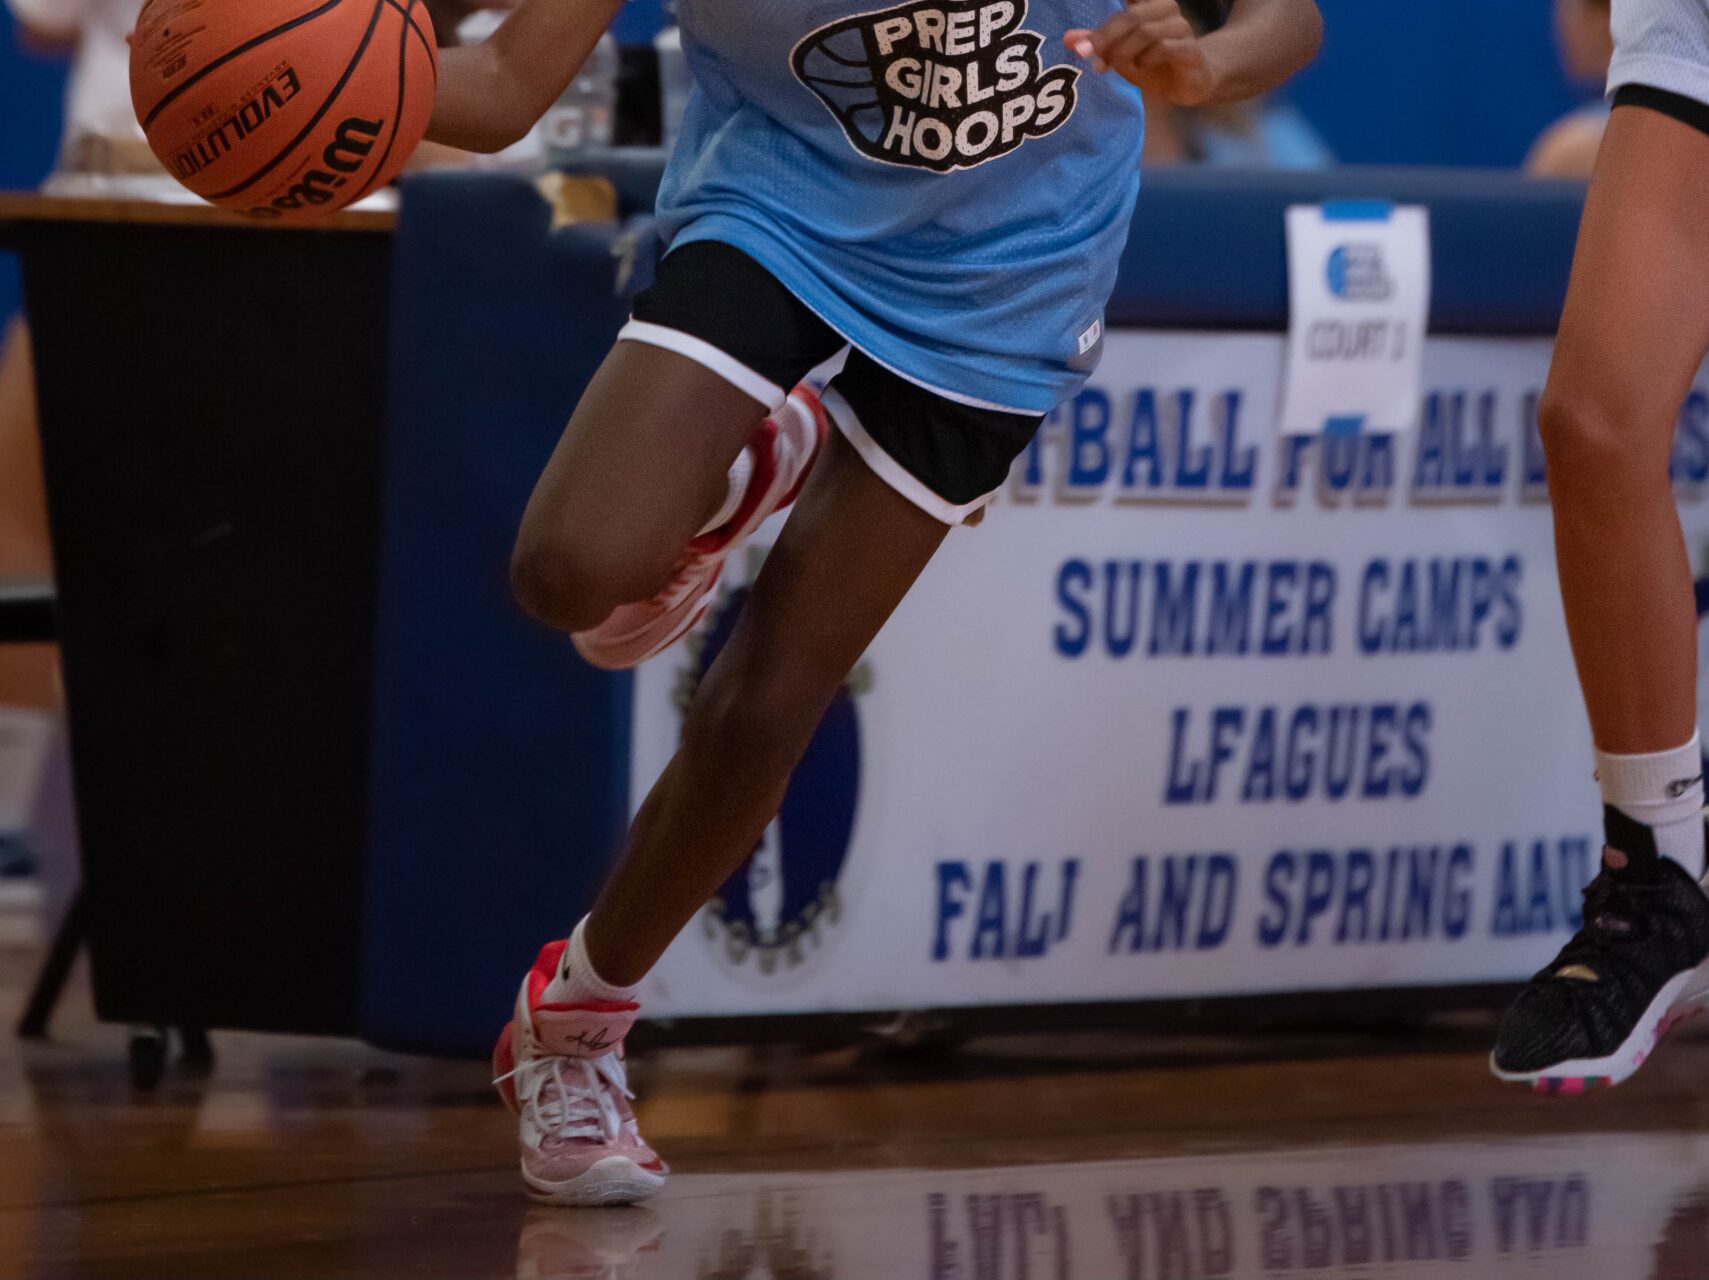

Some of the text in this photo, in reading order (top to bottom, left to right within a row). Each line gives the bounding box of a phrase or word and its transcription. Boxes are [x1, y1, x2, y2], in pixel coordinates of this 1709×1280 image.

[873, 1, 1014, 56] PREP
[885, 44, 1028, 108] GIRLS
[234, 117, 384, 218] Wilso
[883, 79, 1065, 160] HOOPS
[1414, 389, 1506, 487] ALL
[1053, 555, 1523, 659] SUMMER CAMPS
[1107, 852, 1238, 955] AND
[1256, 842, 1473, 948] SPRING
[1489, 836, 1590, 936] AAU
